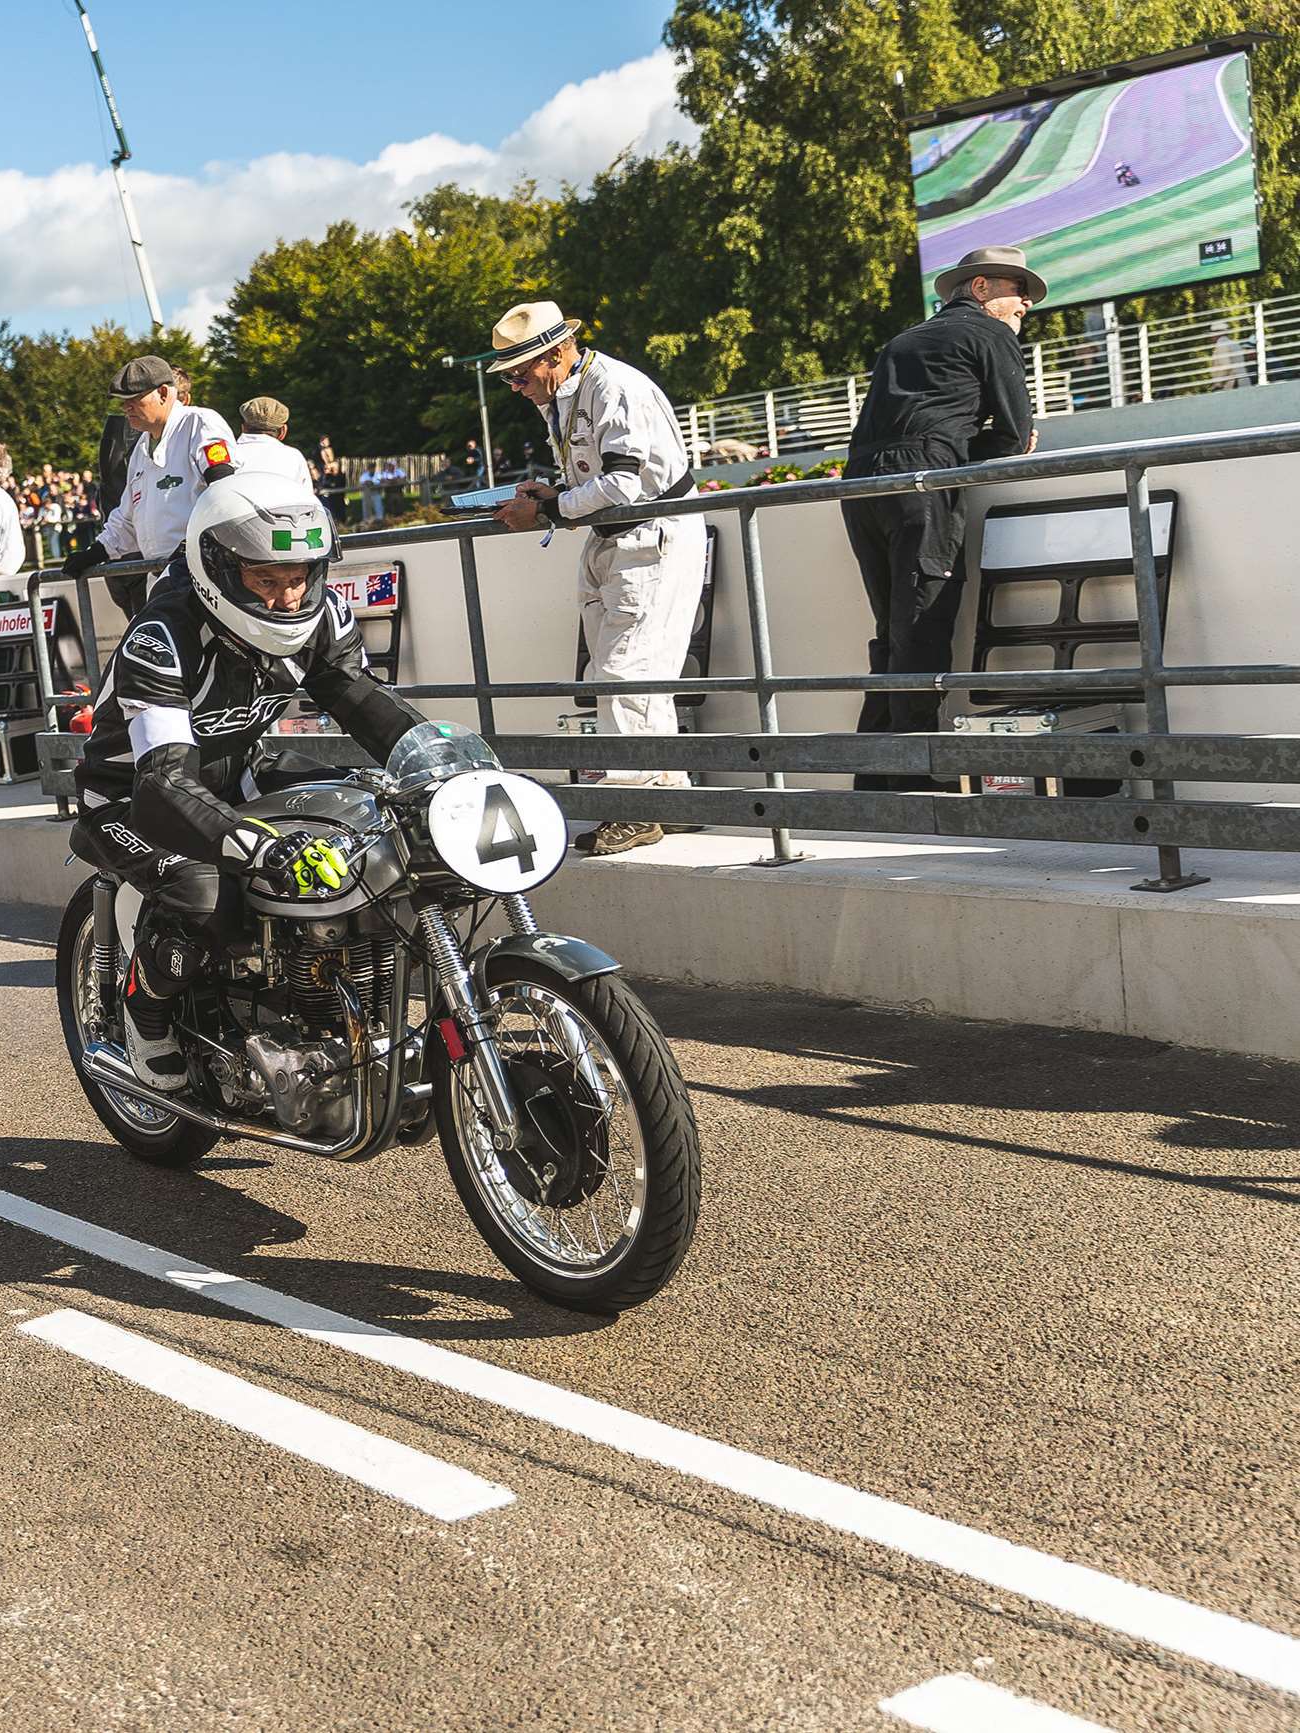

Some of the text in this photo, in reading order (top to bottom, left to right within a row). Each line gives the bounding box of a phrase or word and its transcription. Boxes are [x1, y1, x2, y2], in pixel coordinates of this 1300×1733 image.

[189, 572, 218, 610] asaki
[324, 582, 360, 601] STL
[129, 631, 174, 656] RST
[101, 822, 154, 854] RST
[476, 783, 538, 874] 4
